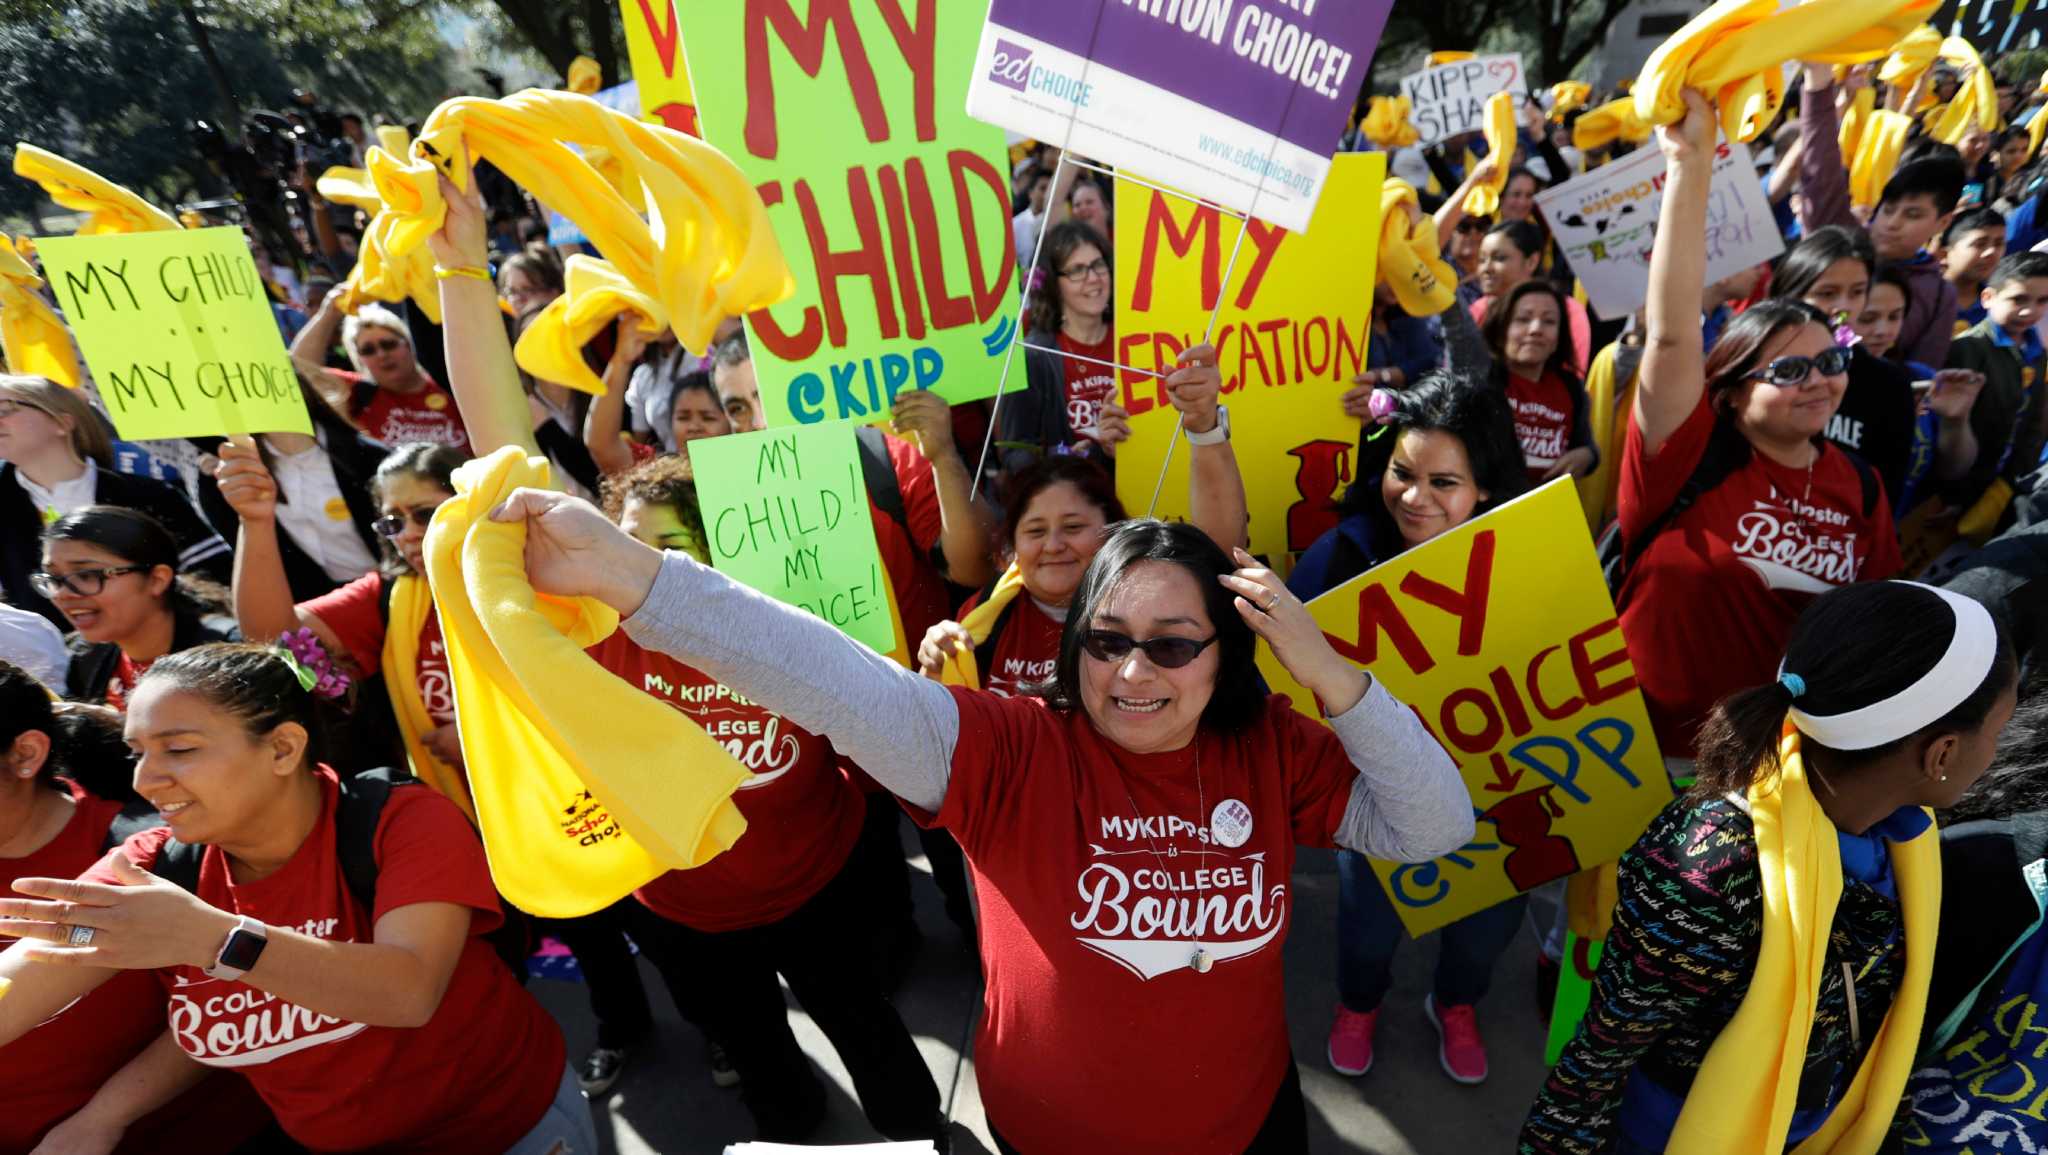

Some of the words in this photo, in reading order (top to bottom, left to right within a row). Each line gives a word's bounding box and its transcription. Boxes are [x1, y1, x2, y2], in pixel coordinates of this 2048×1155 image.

[743, 0, 937, 160] MY
[1233, 5, 1352, 100] CHOICE!
[1408, 62, 1485, 108] KIPP
[1131, 190, 1289, 312] MY
[65, 259, 141, 320] MY
[159, 251, 256, 304] CHILD
[110, 360, 187, 413] MY
[196, 361, 299, 404] CHOICE
[1119, 308, 1374, 417] EDCATION
[757, 434, 802, 485] MY
[715, 462, 859, 559] CHILD!
[783, 544, 823, 588] MY
[1732, 511, 1856, 584] Bound
[1321, 529, 1496, 677] MY
[644, 673, 674, 696] My
[1003, 657, 1025, 676] My
[1410, 618, 1640, 769] OICE
[706, 720, 761, 737] LEGE
[565, 813, 609, 838] Scho
[580, 818, 620, 847] Choi
[1070, 861, 1274, 939] Bound
[1133, 867, 1248, 891] COLLEGE
[168, 995, 341, 1058] Boun
